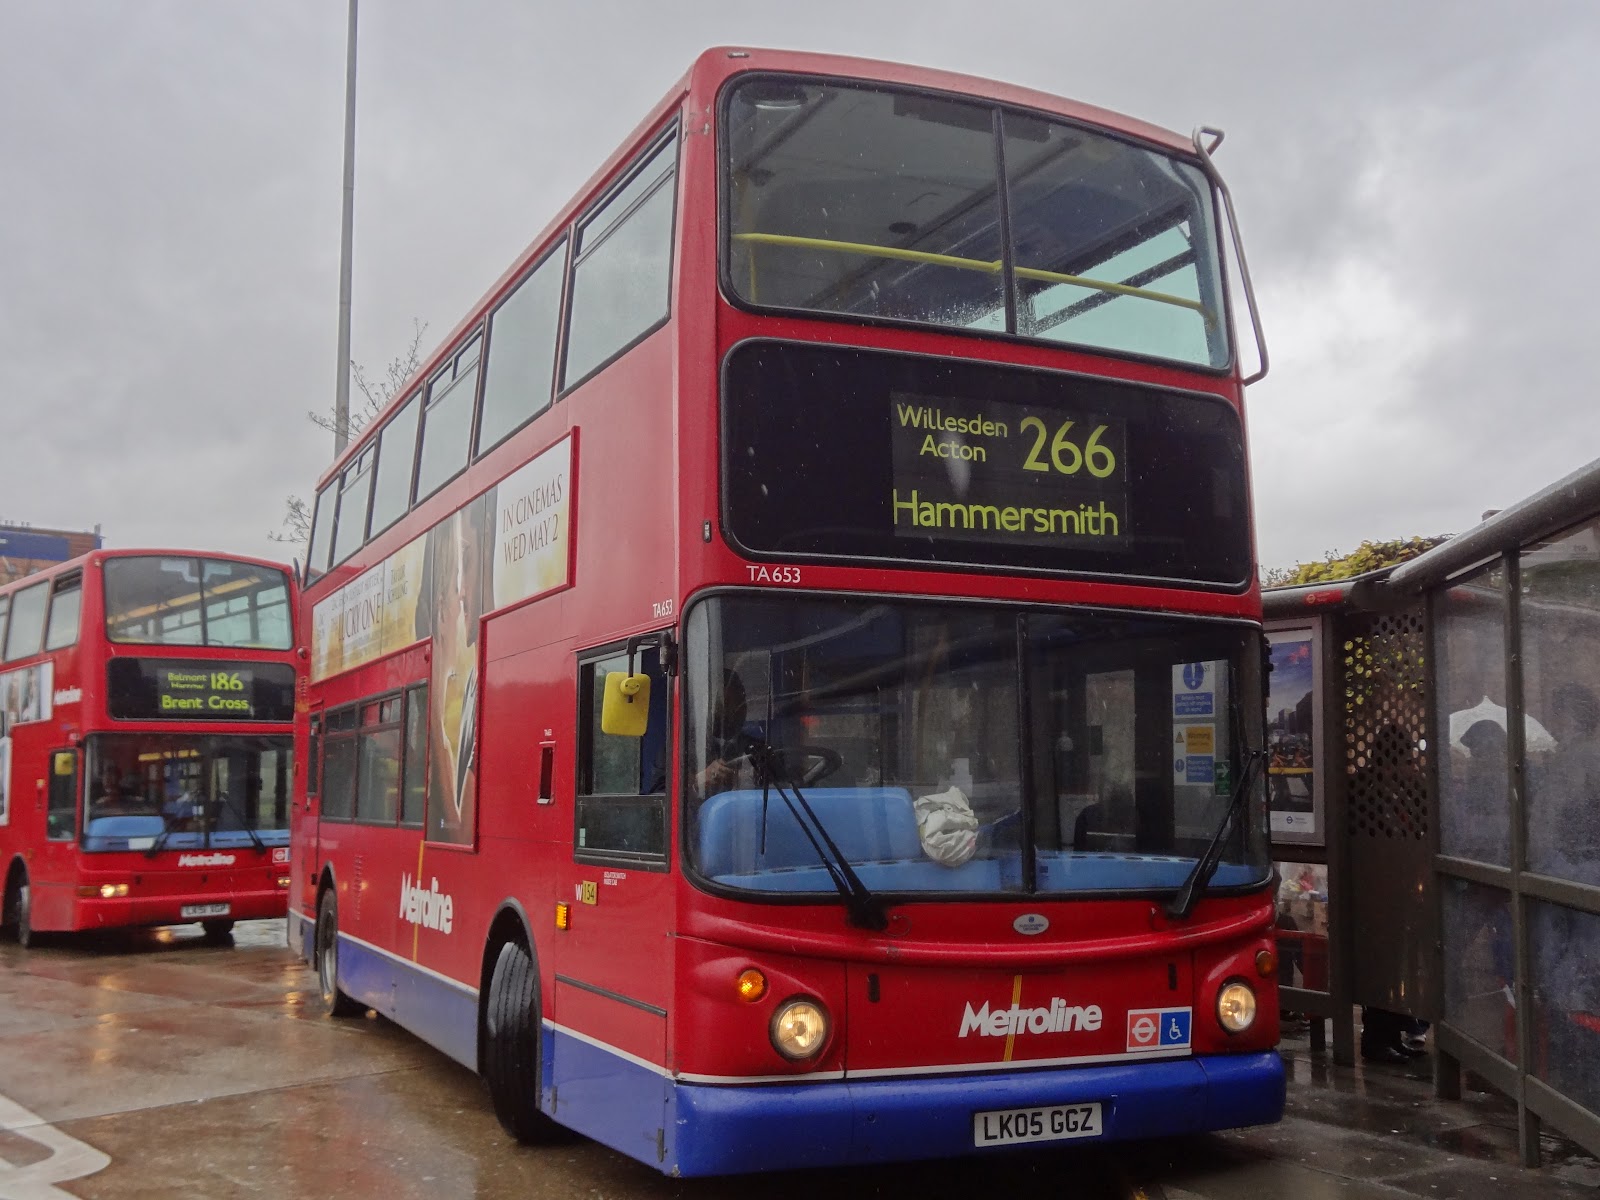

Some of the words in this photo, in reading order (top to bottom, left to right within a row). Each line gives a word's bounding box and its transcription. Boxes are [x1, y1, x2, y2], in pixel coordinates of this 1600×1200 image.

[897, 403, 1008, 438] Willesden
[919, 434, 987, 462] Acton
[1020, 416, 1116, 478] 266
[502, 504, 514, 534] IN
[516, 473, 562, 525] CINEMAS
[893, 488, 1119, 536] Hammersmith
[504, 532, 527, 567] WED
[528, 517, 551, 555] MAY
[552, 513, 559, 542] 2
[652, 599, 673, 619] TA653
[167, 672, 207, 682] Belmont
[210, 672, 244, 691] 186
[162, 694, 203, 710] Brent
[208, 695, 250, 710] Cross
[178, 852, 236, 868] Metroline
[399, 871, 453, 935] Metroline
[958, 997, 1102, 1038] Metroline
[983, 1110, 1044, 1142] LK05
[1050, 1107, 1094, 1136] GGZ
